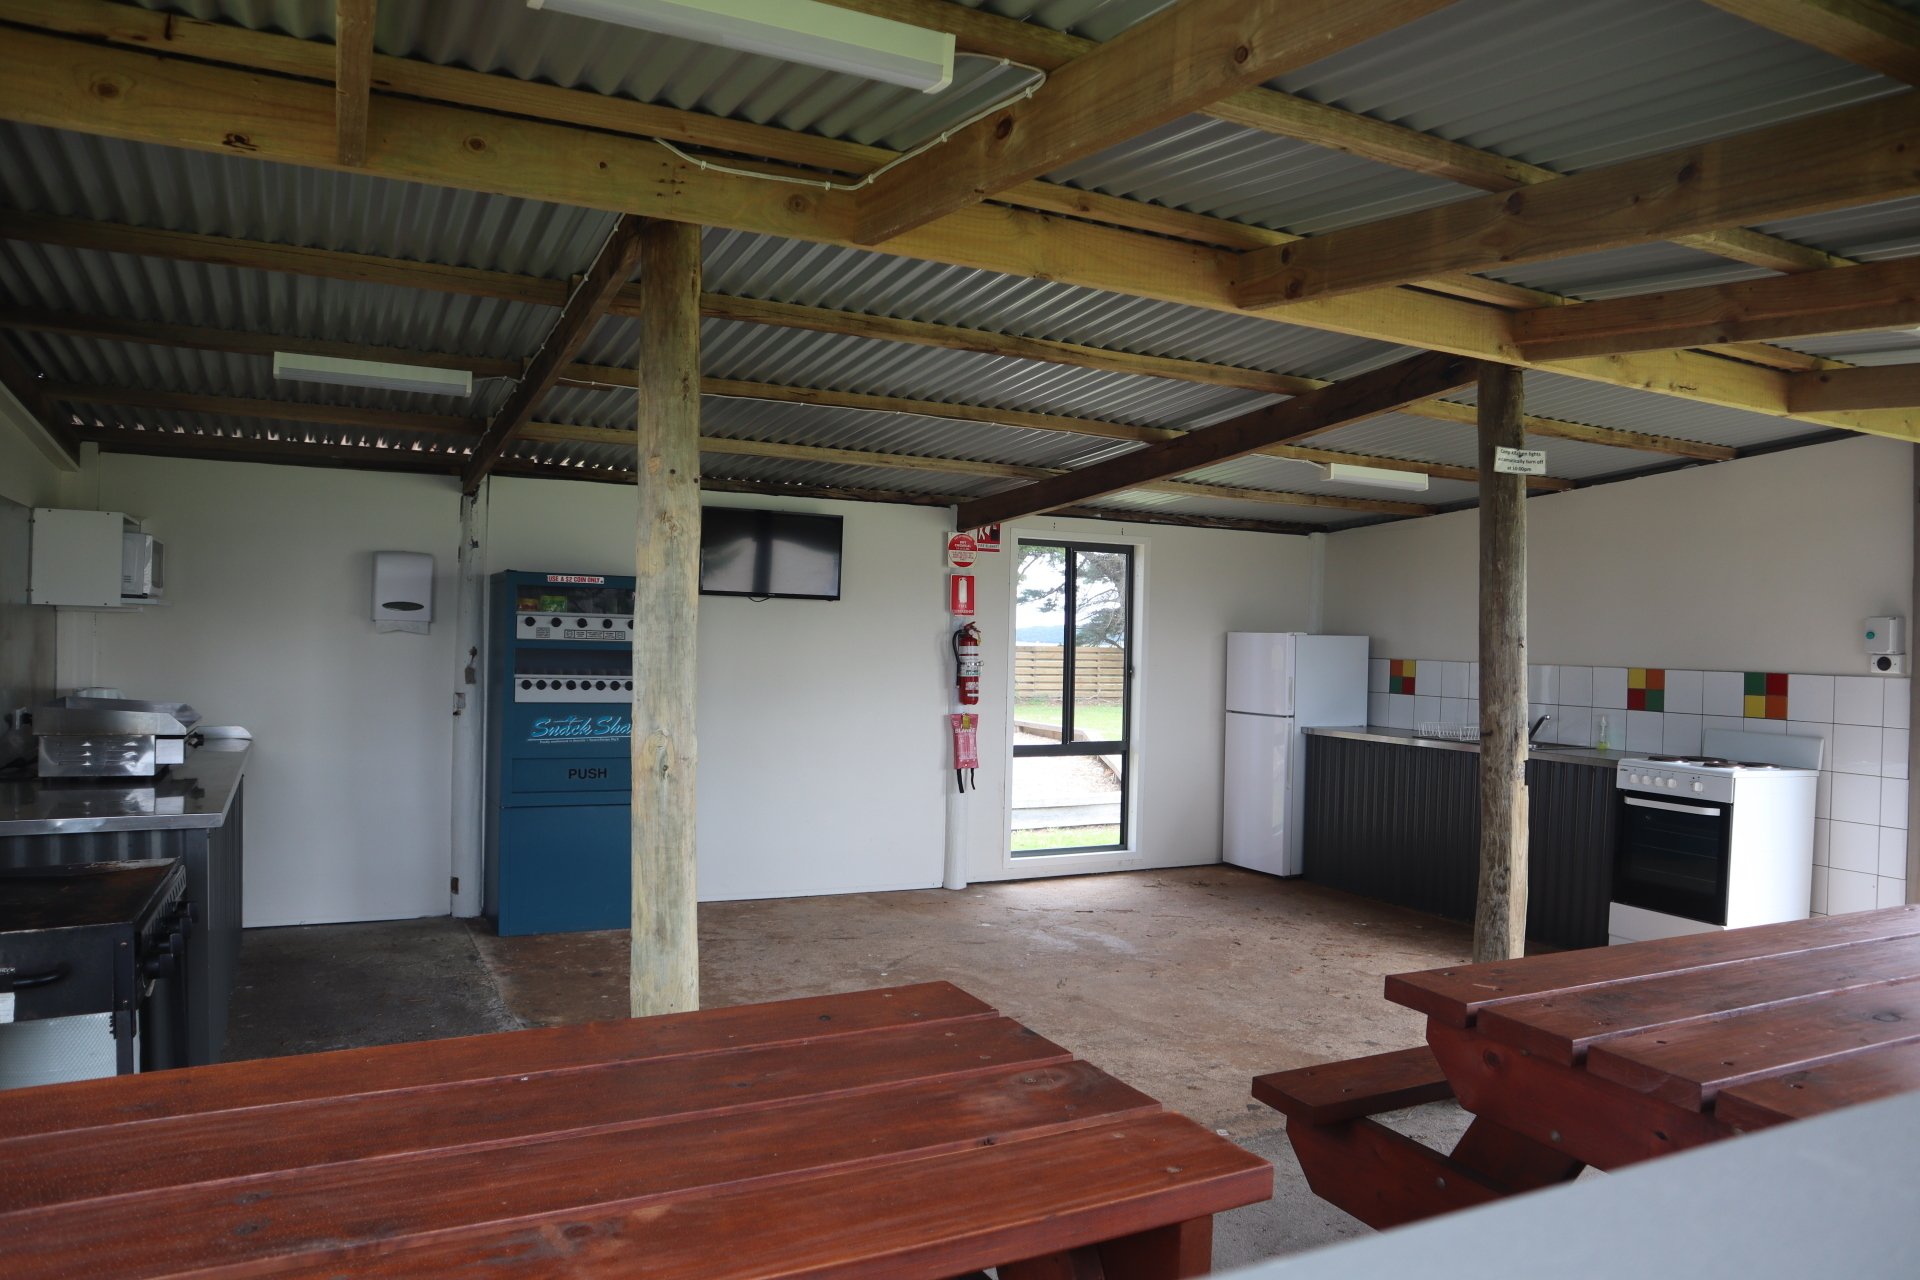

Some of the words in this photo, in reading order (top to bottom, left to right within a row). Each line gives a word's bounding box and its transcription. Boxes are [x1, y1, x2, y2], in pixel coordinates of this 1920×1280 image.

[532, 716, 592, 737] Snack
[594, 716, 632, 735] Sha
[568, 768, 607, 779] PUSH
